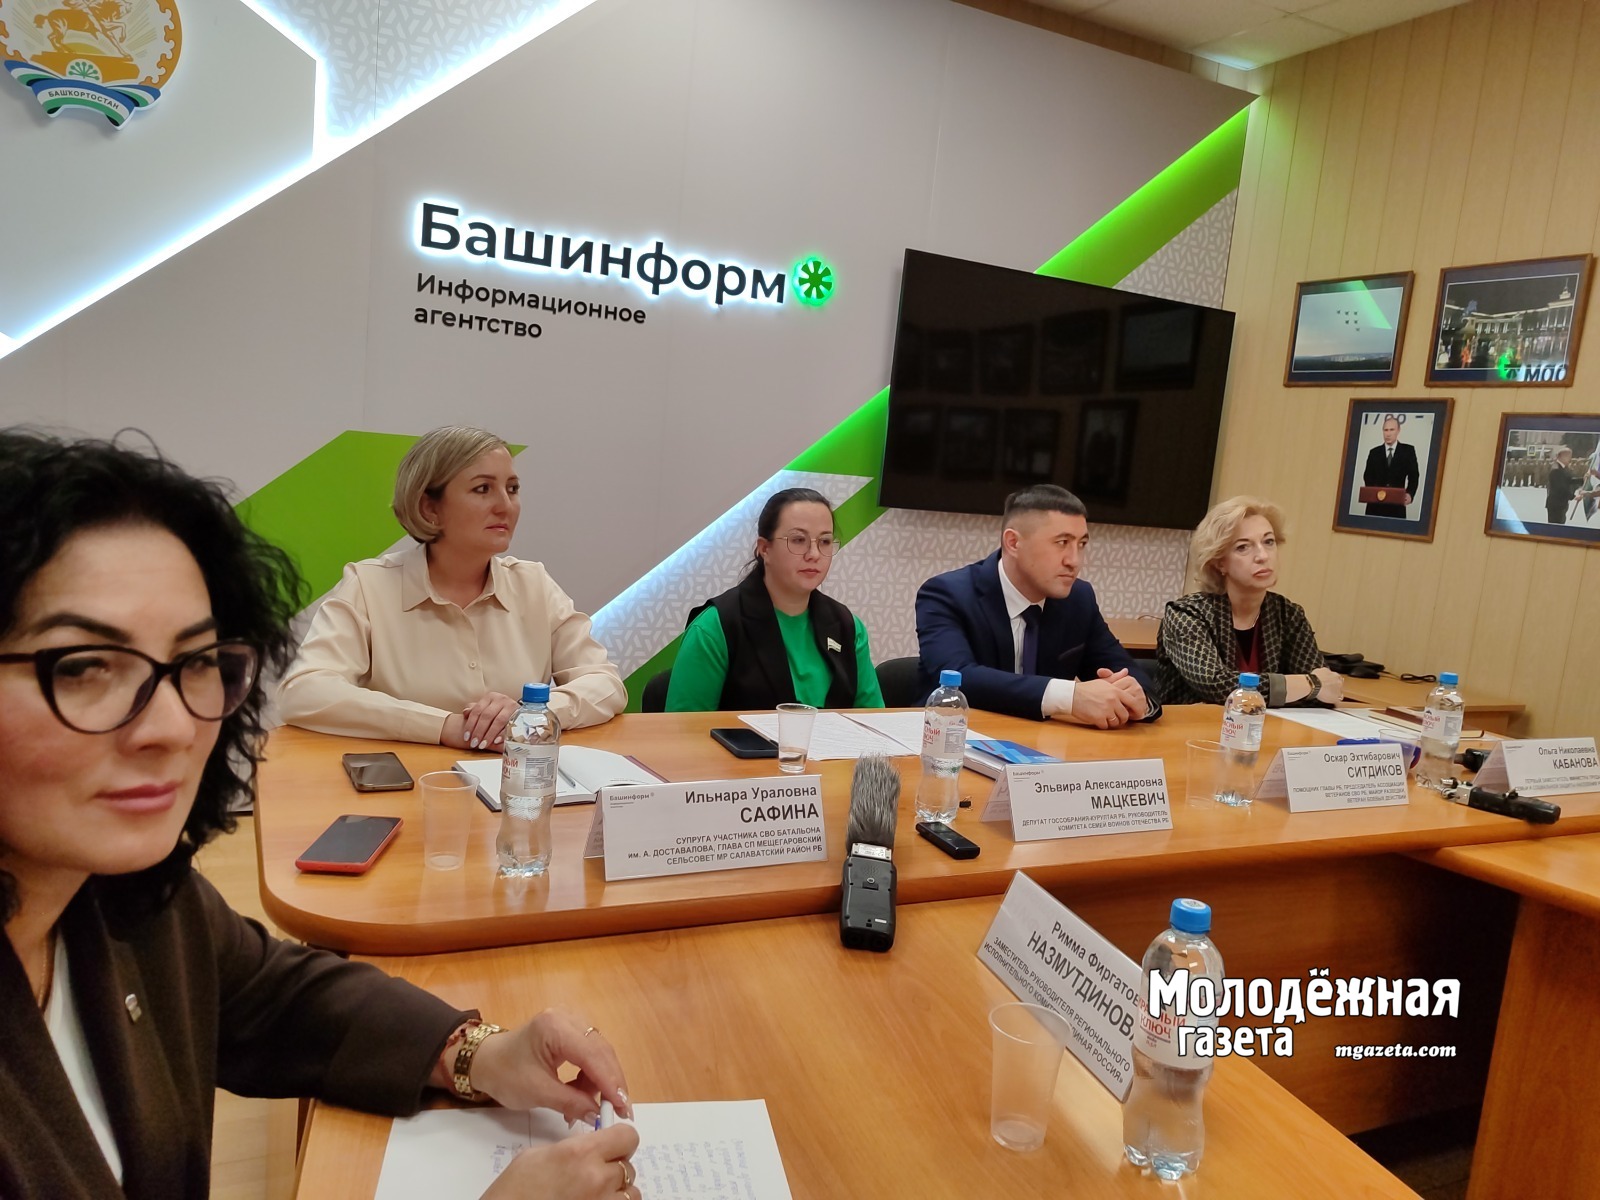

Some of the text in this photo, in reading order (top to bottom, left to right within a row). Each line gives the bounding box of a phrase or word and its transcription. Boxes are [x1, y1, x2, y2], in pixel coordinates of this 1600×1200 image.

[420, 202, 787, 306] Башинформ
[416, 272, 647, 324] Информационное
[413, 305, 543, 338] агентство
[1323, 751, 1401, 764] Оскар Эхтибарович
[1553, 757, 1599, 769] КАБАНОВА
[1347, 764, 1403, 779] СИТДИКОВ
[685, 786, 817, 804] Ильнара Ураловна
[1034, 778, 1163, 794] Эльвира Александровна
[1091, 792, 1167, 811] МАЦКЕВИЧ
[740, 803, 820, 823] САФИНА
[1022, 818, 1048, 827] ДЕПУТАТ
[1127, 810, 1168, 819] РУКОВОДИТЕЛЬ
[676, 826, 821, 845] СУПРУГА УЧАСТНИКА СВО БАТАЛЬОНА
[1058, 823, 1088, 832] КОМИТЕТА
[1131, 818, 1162, 827] ОТЕЧЕСТВА
[628, 834, 822, 859] им. А. ДОСТАВАЛОВА, ГЛАВА СП МЕЩЕГАРОВСКИЙ
[666, 844, 823, 866] СЕЛЬСОВЕТ МР САЛАВАТСКИЙ РАЙОН РБ
[1051, 920, 1086, 960] Римма
[983, 942, 1034, 994] ИСПОЛНИТЕЛЬНОГО
[1027, 931, 1134, 1041] НАЗМУТДИНОВ
[993, 937, 1131, 1072] ЗАМЕСТИТЕЛЬ РУКОВОДИТЕЛЯ РЕГИОНАЛЬНОГО
[1141, 1014, 1171, 1039] КЛЮЧ
